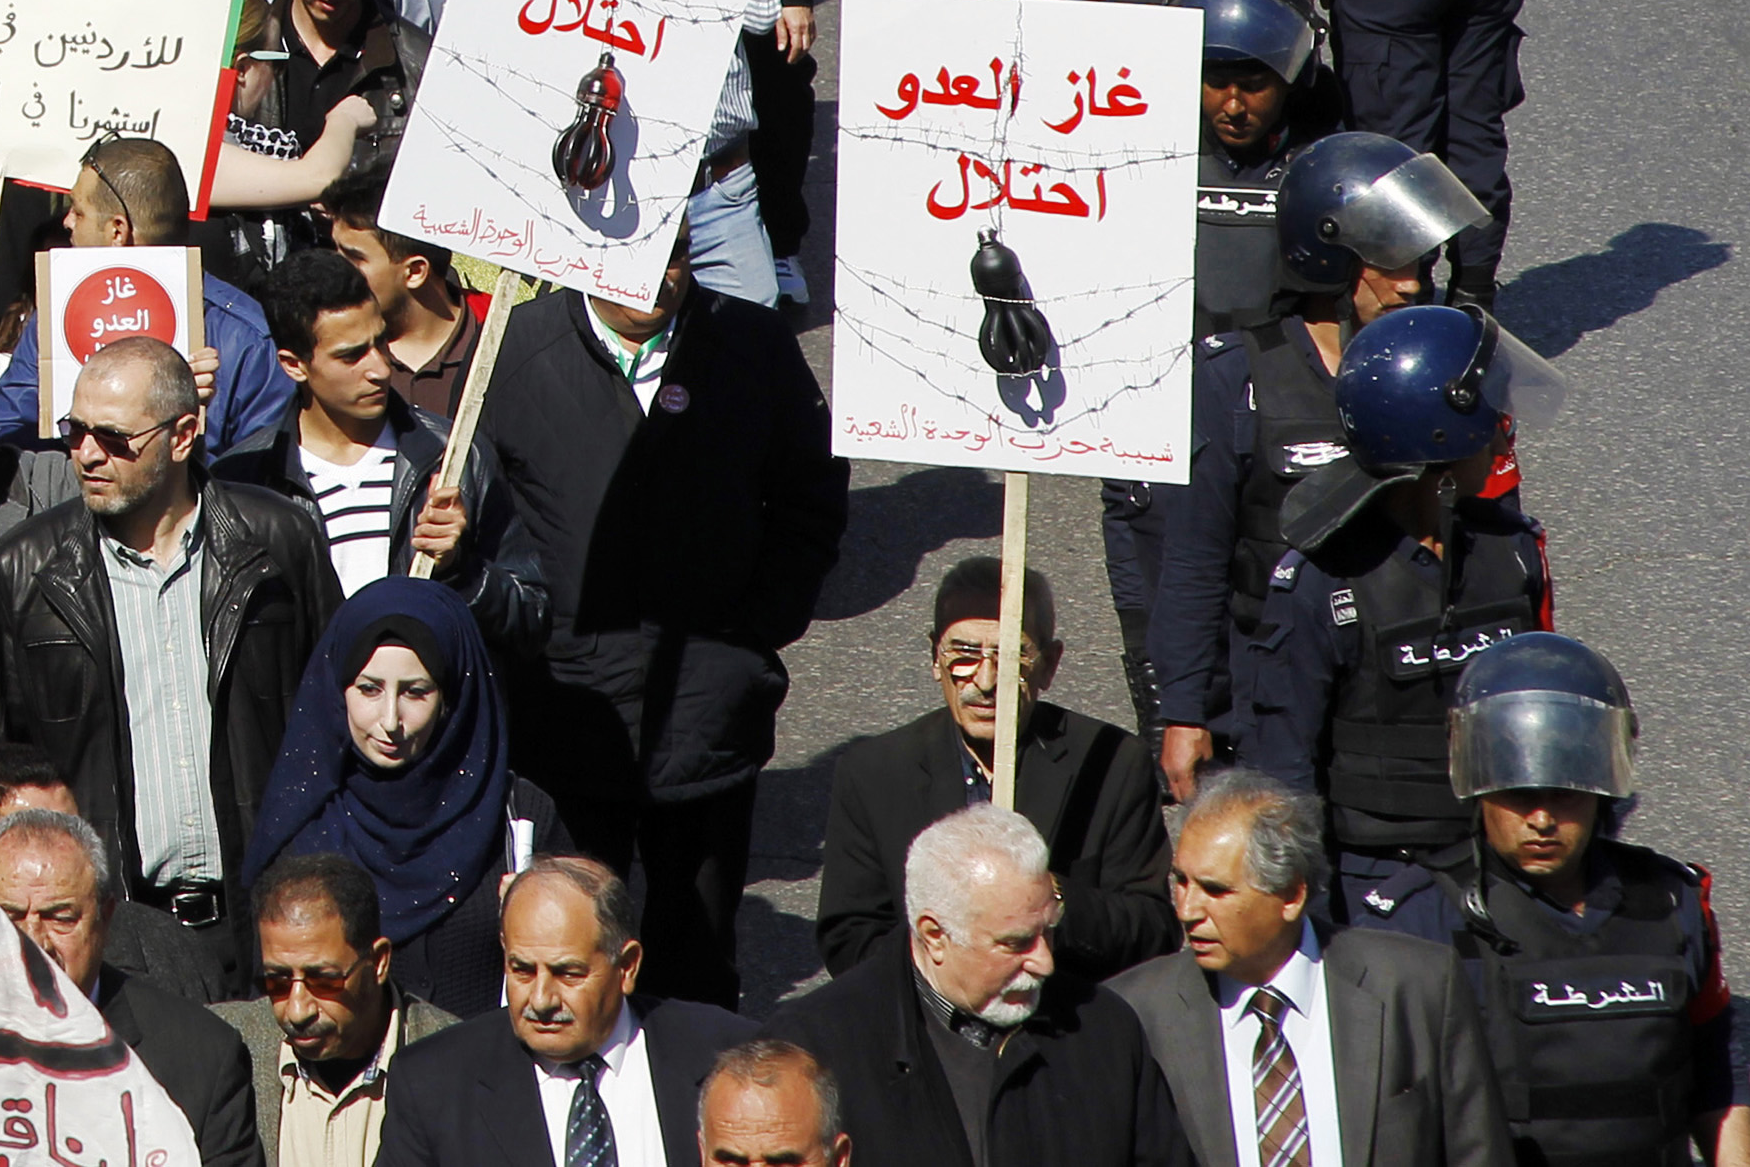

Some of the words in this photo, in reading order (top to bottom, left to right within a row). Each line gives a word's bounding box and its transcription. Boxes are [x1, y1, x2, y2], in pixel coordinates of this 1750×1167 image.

[34, 22, 184, 71] للأردنيين
[21, 81, 47, 128] في
[874, 57, 1023, 120] العدو
[1040, 67, 1149, 134] غاز
[68, 91, 161, 141] استثمرنا
[926, 152, 1107, 222] احتلال
[412, 204, 483, 238] الشعبية
[478, 218, 535, 260] الوحدة
[534, 247, 590, 277] حزب
[101, 276, 138, 305] غاز
[592, 262, 652, 305] شبيبة
[90, 309, 150, 338] العدو
[843, 404, 918, 441] الشعبية
[923, 412, 1004, 451] الوحدة
[1098, 441, 1174, 464] شبيبة
[1532, 981, 1665, 1009] الشرطة
